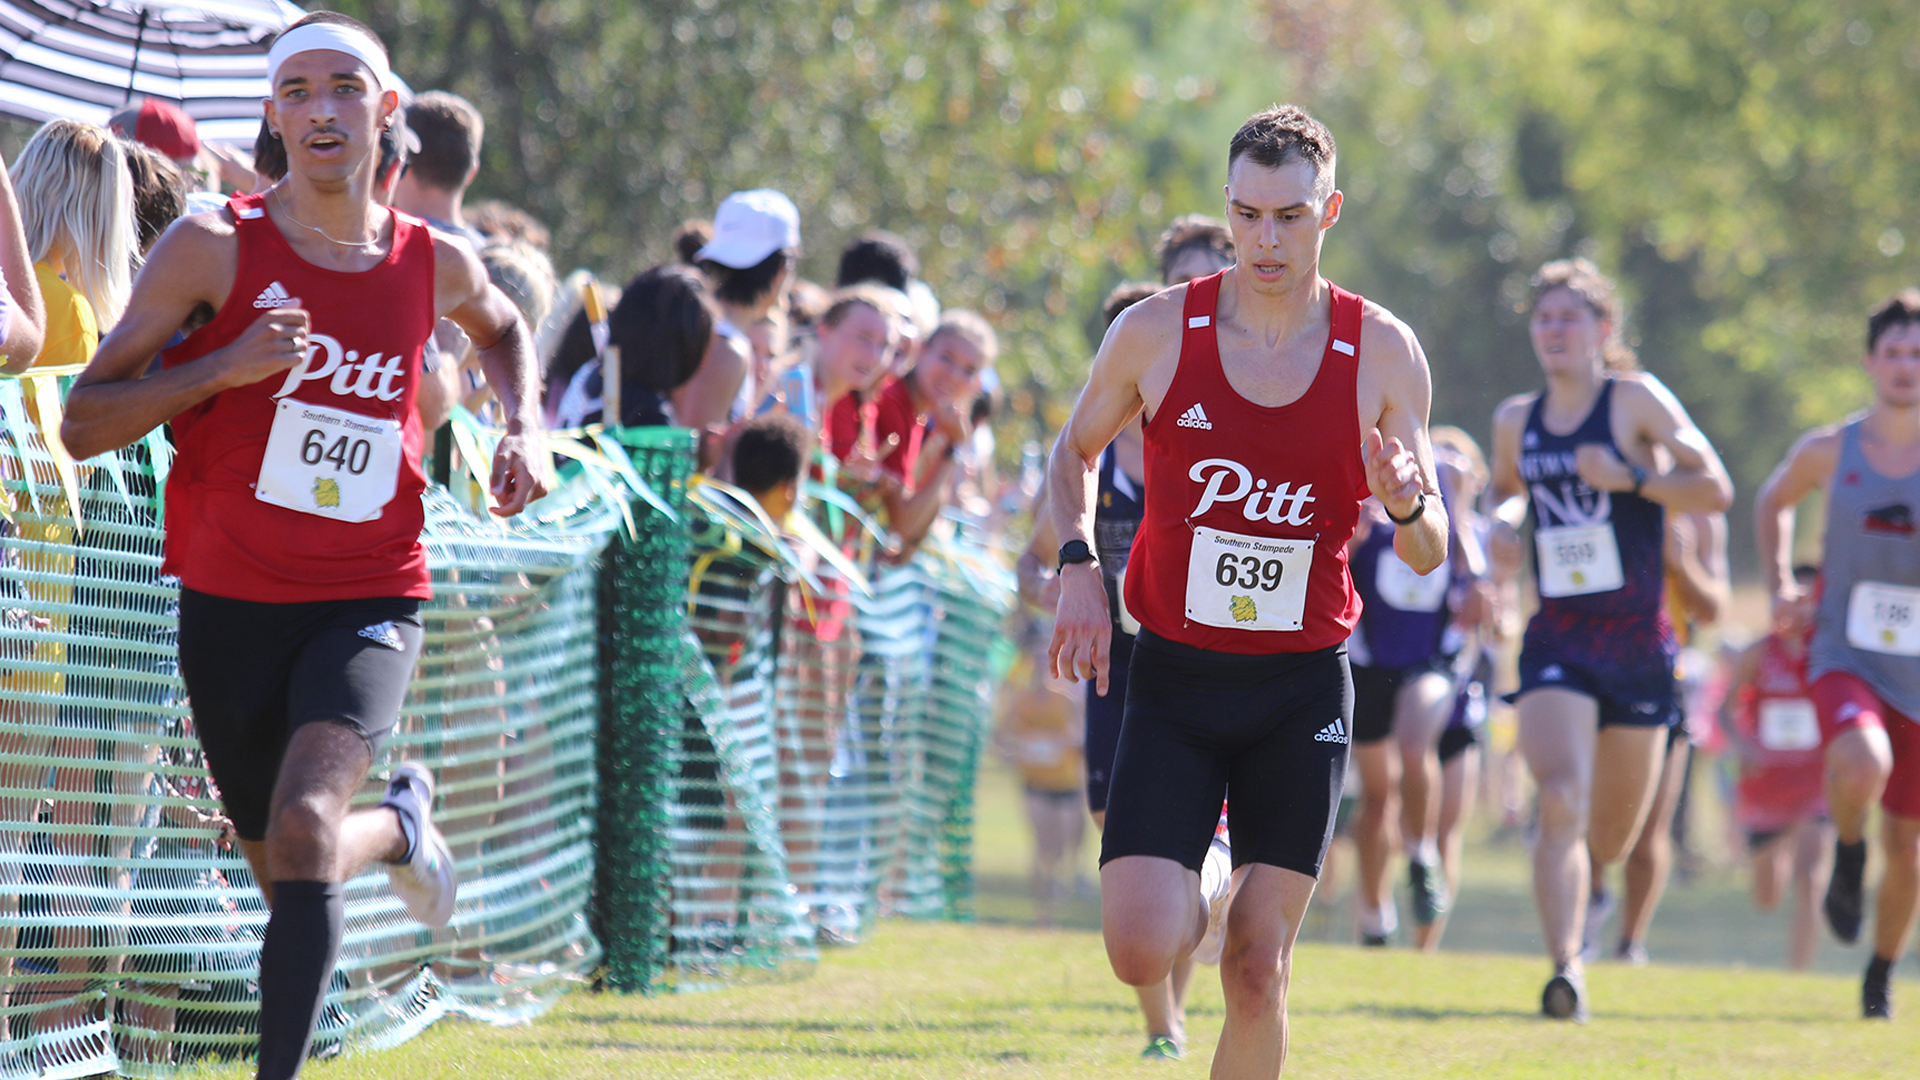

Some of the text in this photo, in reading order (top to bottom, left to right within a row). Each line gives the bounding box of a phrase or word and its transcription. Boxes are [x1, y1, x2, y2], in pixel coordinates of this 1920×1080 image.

[272, 333, 405, 402] Pitt
[301, 410, 383, 434] Southern Stampede
[1176, 418, 1213, 430] adidas
[301, 428, 371, 476] 640
[1188, 458, 1317, 527] Pitt
[1214, 535, 1295, 555] Southern Stampede
[1215, 552, 1284, 592] 639
[356, 629, 405, 651] adidas
[1314, 732, 1348, 745] adidas
